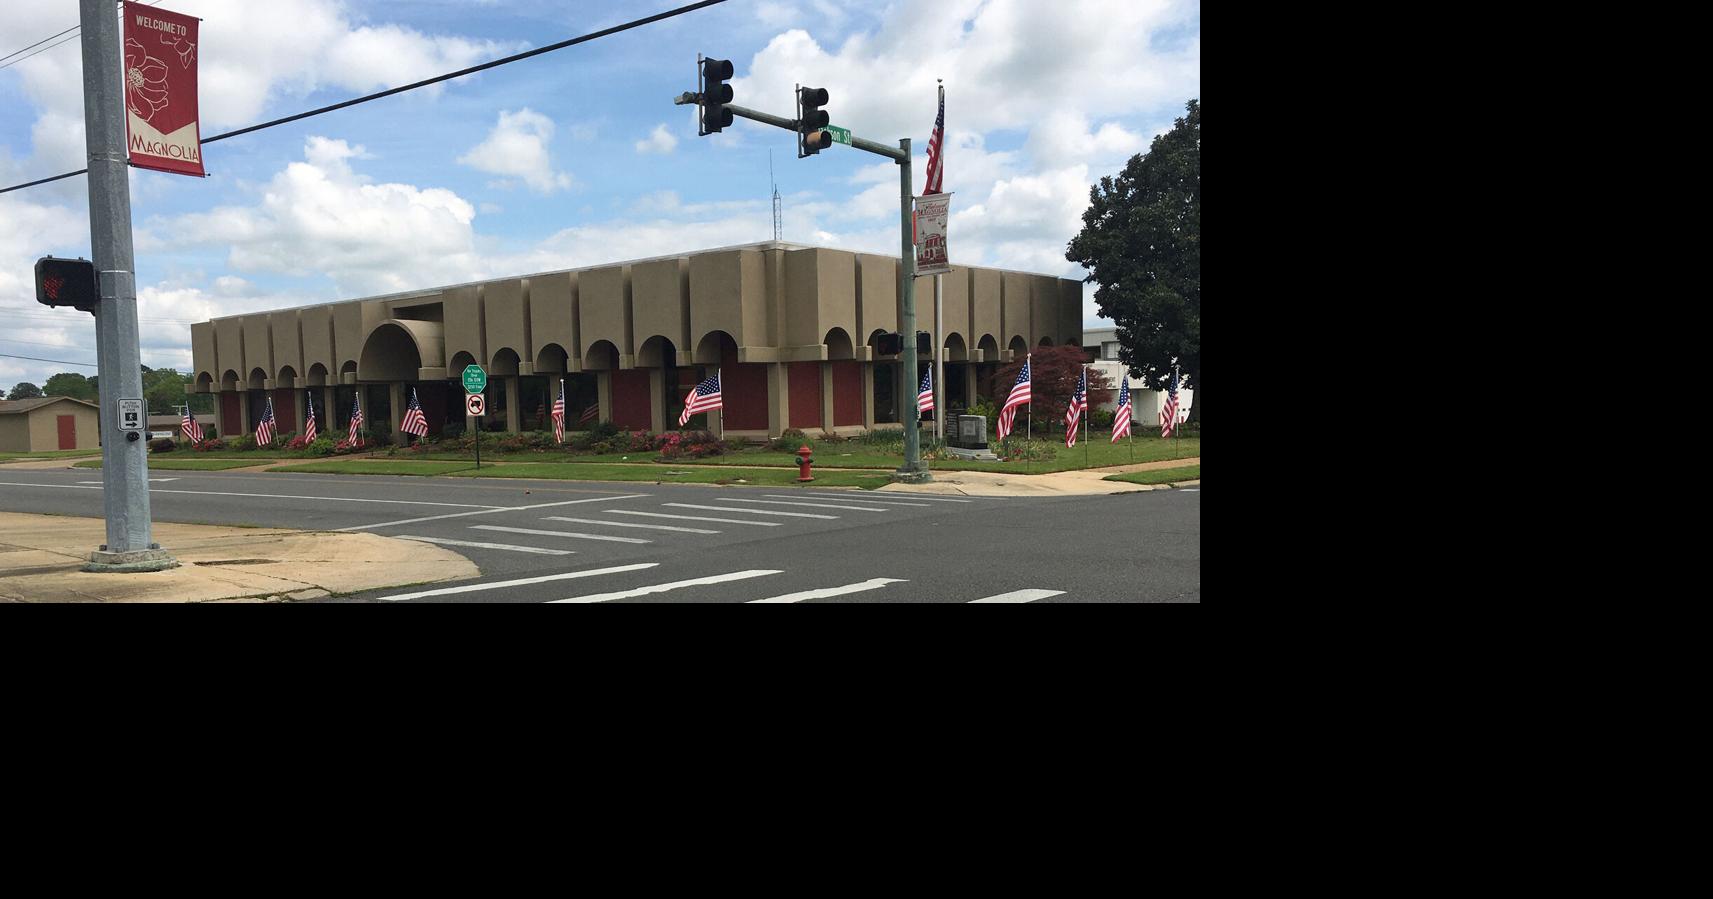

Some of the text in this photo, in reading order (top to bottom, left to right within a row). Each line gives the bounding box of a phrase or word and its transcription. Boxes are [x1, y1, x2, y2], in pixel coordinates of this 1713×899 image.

[136, 15, 187, 36] WELCOME TO
[843, 130, 851, 144] St
